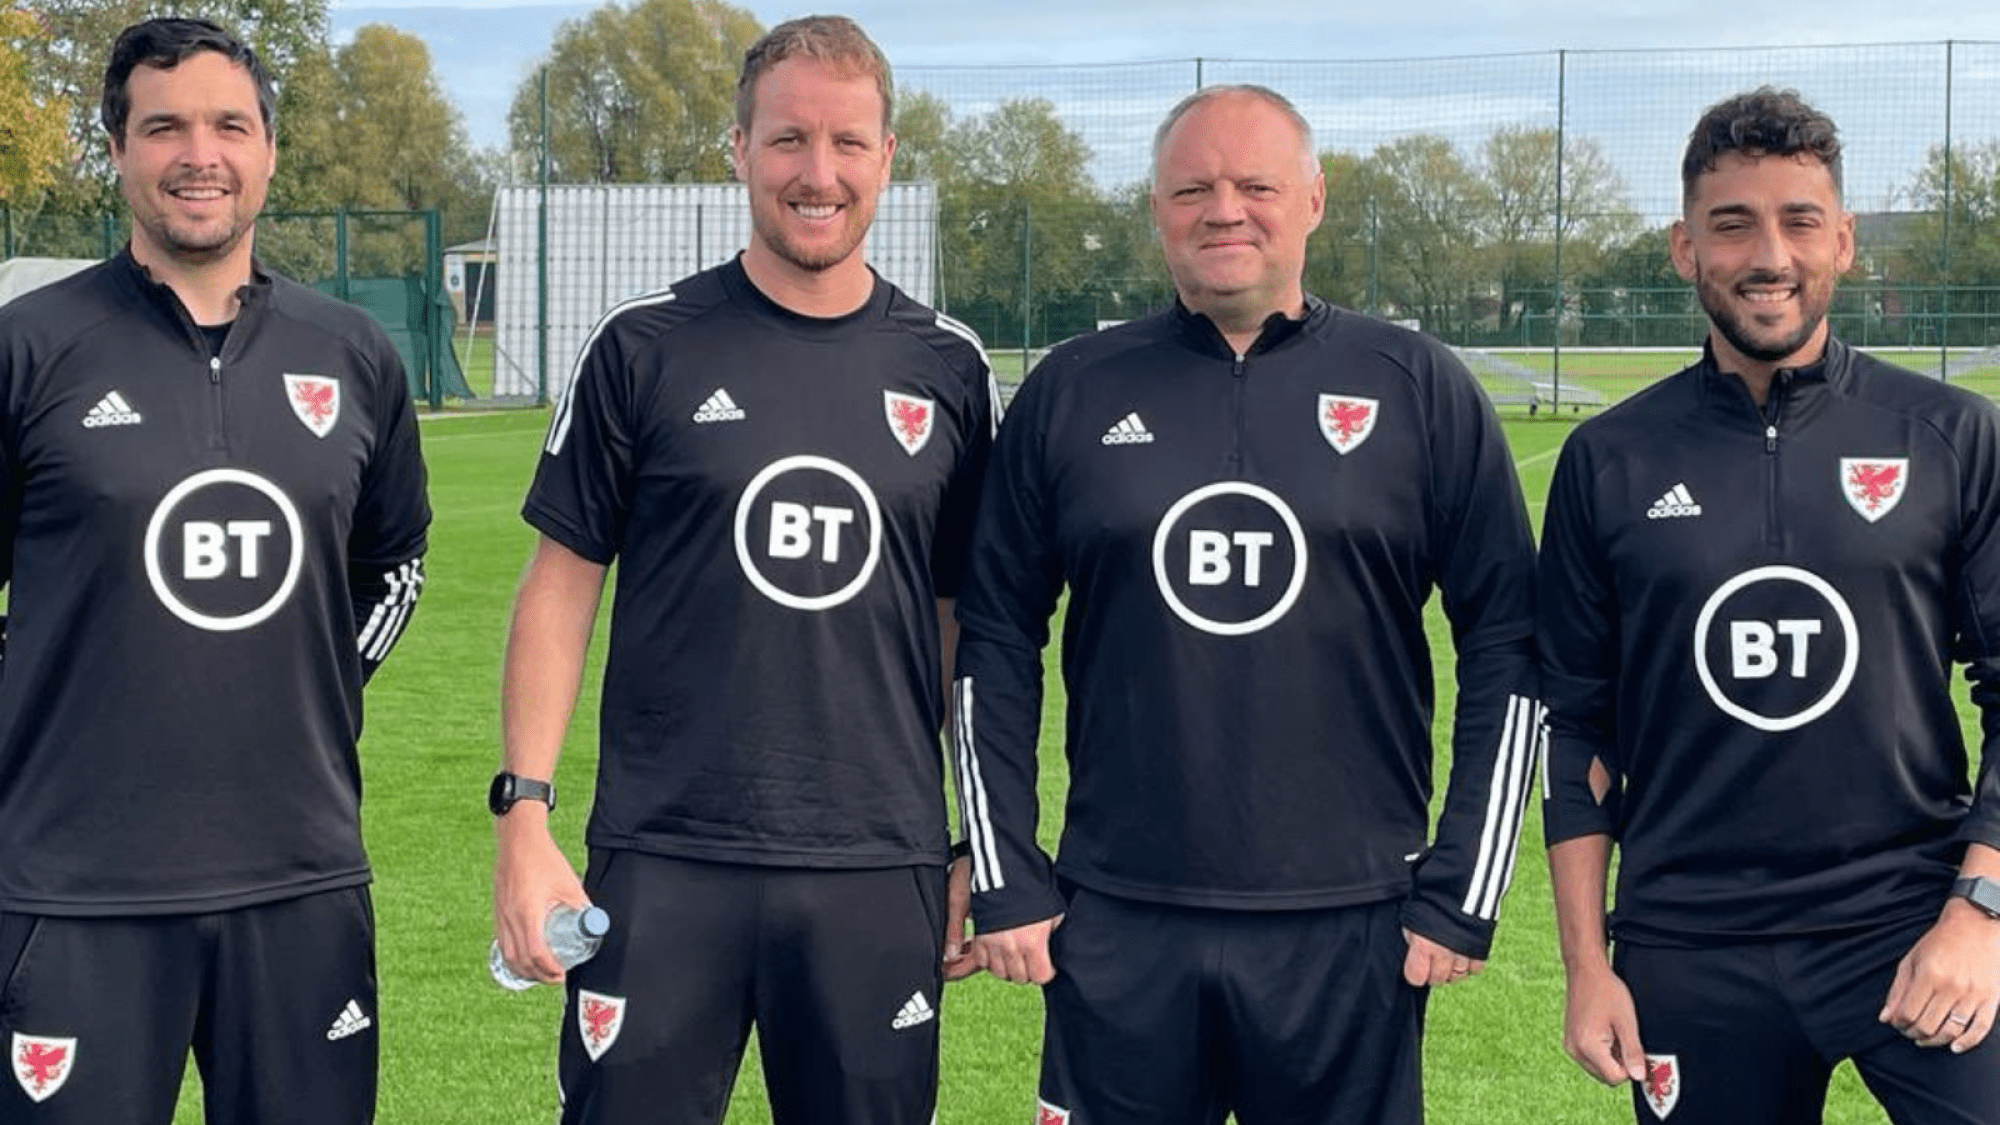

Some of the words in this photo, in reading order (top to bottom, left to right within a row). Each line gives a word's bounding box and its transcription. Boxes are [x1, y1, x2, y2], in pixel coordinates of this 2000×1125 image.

[82, 412, 143, 428] adidas
[693, 407, 746, 424] adidas
[1102, 431, 1155, 446] adidas
[1647, 503, 1702, 520] adidas
[184, 521, 272, 579] BT
[769, 502, 854, 563] BT
[1189, 530, 1274, 587] BT
[1731, 619, 1821, 678] BT
